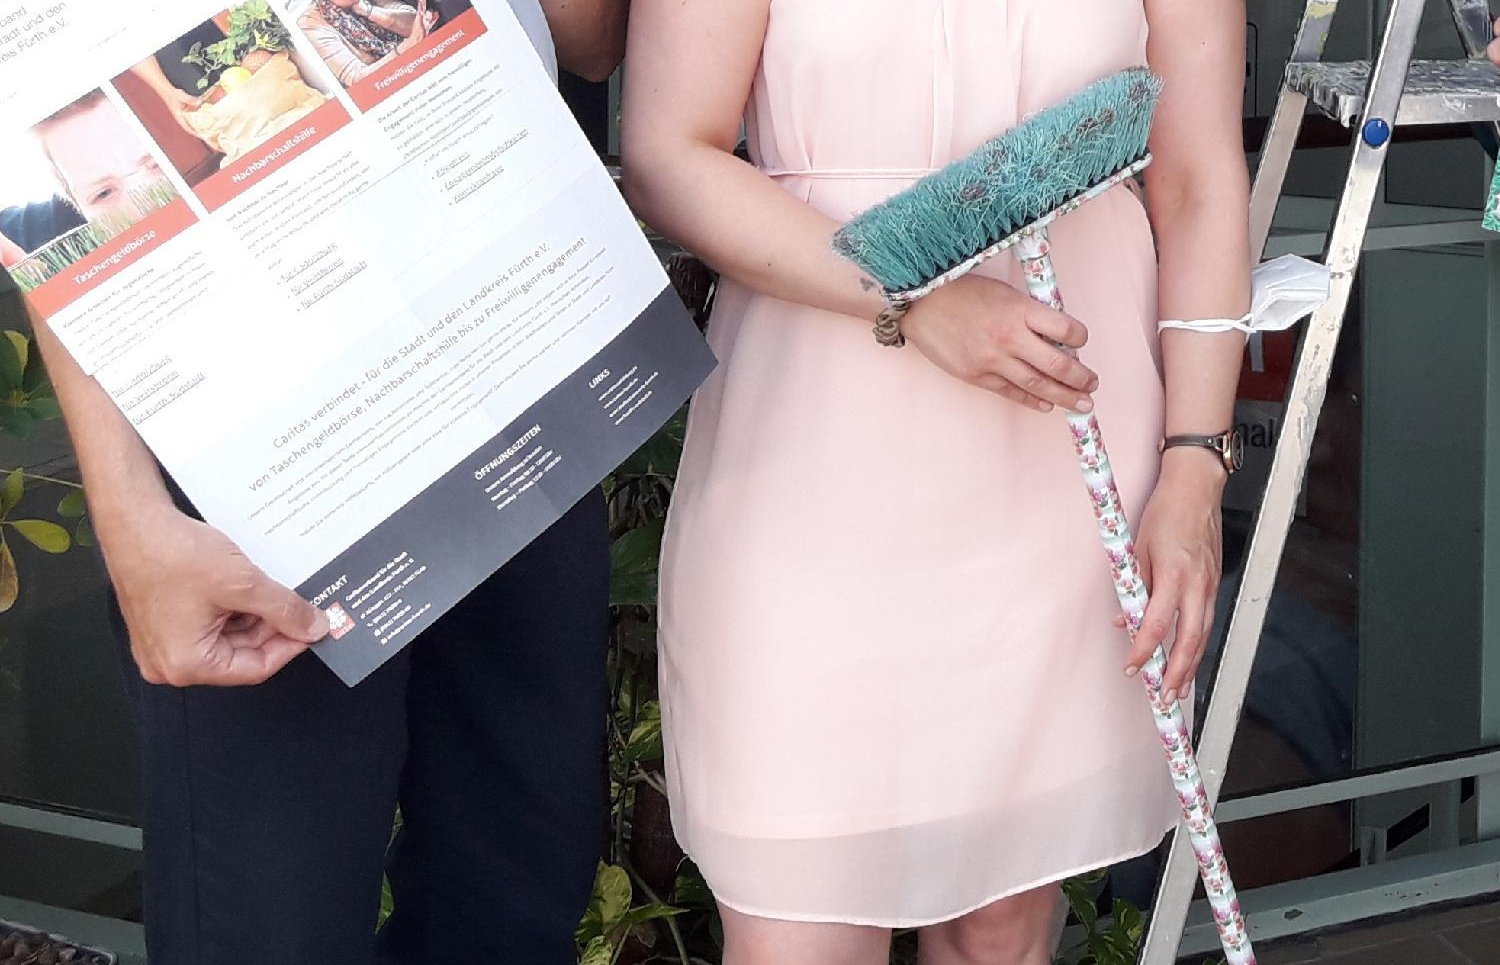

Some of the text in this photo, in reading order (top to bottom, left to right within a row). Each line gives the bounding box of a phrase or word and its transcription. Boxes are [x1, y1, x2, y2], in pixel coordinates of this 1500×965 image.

[22, 14, 44, 31] und
[46, 2, 67, 18] den
[373, 27, 466, 93] Freiwilligenengagement
[230, 123, 317, 185] Nachbarschaftshilfe
[71, 226, 158, 288] Taschengeldbörse
[246, 236, 590, 493] von Taschengeldbörse, Nachbarschaftshilfe bis zu Freiwilligenengagement
[271, 416, 312, 450] Caritas
[308, 379, 362, 423] verbindet
[364, 364, 383, 382] für
[379, 351, 400, 370] die
[397, 332, 427, 358] Stadt
[424, 319, 446, 338] und
[442, 304, 464, 324] den
[460, 271, 510, 310] Landkreis
[506, 252, 535, 277] Fürth
[531, 241, 550, 259] e.V.
[586, 368, 612, 389] LINKS
[472, 422, 543, 482] ÖFFNUNGSZEITEN
[308, 573, 350, 608] ONTAKT
